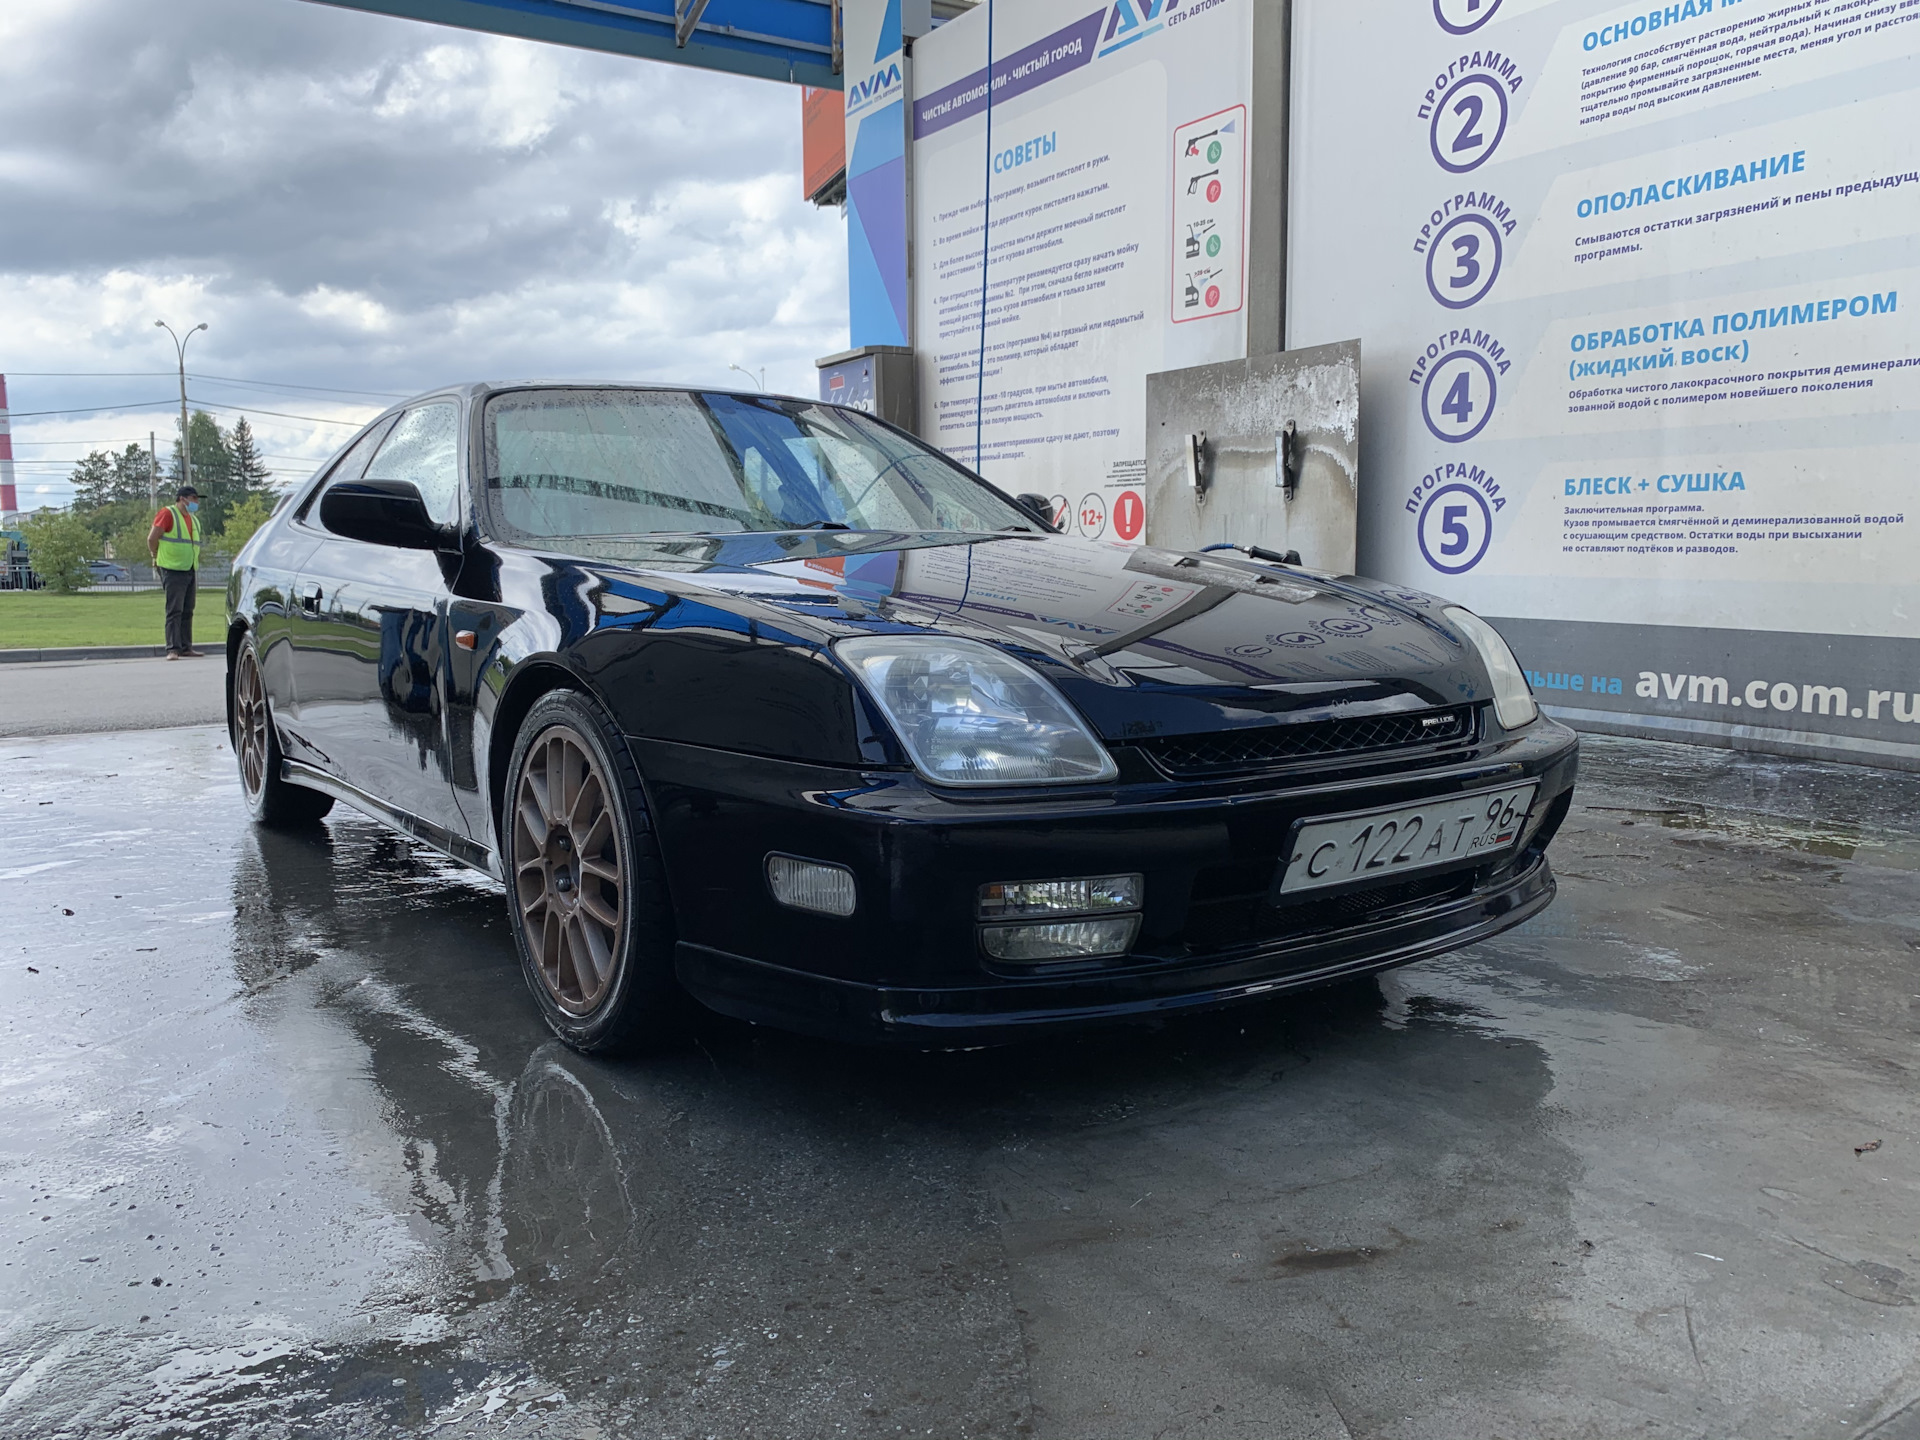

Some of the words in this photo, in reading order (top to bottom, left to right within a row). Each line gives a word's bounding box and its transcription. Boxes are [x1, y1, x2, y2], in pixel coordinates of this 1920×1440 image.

[1168, 10, 1188, 27] СЕТЬ
[1582, 0, 1712, 51] ОСНОВНАЯ
[1582, 56, 1631, 76] Технология
[1633, 36, 1696, 60] способствует
[1698, 15, 1765, 43] растворению
[1767, 0, 1811, 19] жирных
[1580, 83, 1626, 101] покрытию
[1628, 63, 1684, 88] фирменный
[1686, 52, 1732, 70] порошок,
[1735, 38, 1776, 56] горячая
[1778, 27, 1811, 43] вода).
[1814, 13, 1861, 33] Начиная
[1864, 4, 1896, 18] снизу
[1580, 94, 1628, 113] тщательно
[1630, 77, 1689, 99] промывайте
[1691, 56, 1760, 82] загрязненные
[1763, 46, 1797, 61] места,
[1800, 35, 1834, 50] меняя
[1836, 28, 1861, 43] угол
[1864, 25, 1872, 33] и
[1581, 70, 1626, 90] (давление
[1628, 65, 1638, 74] 90
[1640, 61, 1659, 71] бар,
[1661, 43, 1717, 65] смягчённая
[1719, 34, 1746, 47] вода,
[1749, 9, 1821, 38] нейтральный
[1824, 8, 1830, 16] к
[848, 63, 902, 109] AVM
[922, 100, 951, 122] ЧИСТЫЕ
[952, 75, 1007, 109] АВТОМОБИЛИ
[1013, 50, 1049, 79] ЧИСТЫЙ
[1051, 37, 1083, 67] ГОРОД
[1418, 50, 1523, 120] ПРОГРАММА
[1579, 112, 1610, 125] напора
[1612, 104, 1636, 116] воды
[1637, 99, 1655, 109] под
[1657, 87, 1700, 104] высоким
[1701, 70, 1761, 94] давлением.
[1452, 96, 1483, 153] 2
[994, 131, 1056, 174] СОВЕТЫ
[1026, 174, 1055, 189] возьмите
[1056, 162, 1085, 179] пистолет
[1577, 150, 1805, 218] ОПОЛАСКИВАНИЕ
[990, 239, 1015, 251] качества
[1064, 212, 1093, 229] моечный
[1094, 204, 1126, 220] пистолет
[998, 211, 1024, 226] держите
[1043, 193, 1075, 210] пистолета
[1413, 192, 1517, 254] ПРОГРАММА
[1575, 227, 1640, 246] Смываются
[1643, 216, 1692, 233] остатки
[1695, 196, 1778, 223] загрязнений
[1782, 196, 1791, 206] и
[1795, 188, 1831, 203] пены
[990, 274, 1025, 289] температуре
[1026, 261, 1072, 282] рекомендуется
[1073, 256, 1091, 268] сразу
[1092, 250, 1115, 262] начать
[1116, 243, 1139, 255] мойку
[1047, 275, 1072, 287] сначала
[1073, 270, 1092, 280] бегло
[1093, 261, 1124, 275] нанесите
[1450, 234, 1480, 288] 3
[1574, 243, 1642, 264] программы.
[1020, 292, 1056, 307] автомобиля
[1062, 285, 1085, 296] только
[1086, 280, 1105, 291] затем
[1006, 335, 1039, 349] (программа
[1061, 322, 1088, 338] грязный
[1102, 310, 1144, 328] недомытый
[1570, 318, 1704, 352] ОБРАБОТКА
[1712, 291, 1897, 334] ПОЛИМЕРОМ
[1023, 344, 1048, 356] который
[1049, 340, 1079, 352] обладает
[1409, 328, 1512, 385] ПРОГРАММА
[1569, 346, 1674, 381] (жидкий
[1681, 339, 1748, 365] воск)
[1047, 382, 1067, 391] мытье
[1078, 388, 1110, 399] включить
[1441, 372, 1473, 423] 4
[1568, 387, 1622, 400] Обработка
[1625, 383, 1668, 393] чистого
[1670, 373, 1764, 390] лакокрасочного
[1767, 366, 1830, 380] покрытия
[1833, 357, 1920, 376] деминерали
[1568, 400, 1615, 413] зованной
[1618, 397, 1650, 409] водой
[1662, 392, 1727, 405] полимером
[1730, 386, 1798, 399] новейшего
[1801, 379, 1873, 392] поколения
[992, 436, 1044, 448] монетоприемники
[1045, 434, 1063, 444] сдачу
[1092, 428, 1120, 437] поэтому
[1405, 462, 1507, 514] ПРОГРАММА
[1564, 476, 1632, 495] БЛЕСК
[1638, 478, 1650, 491] +
[1656, 471, 1745, 493] СУШКА
[1082, 509, 1103, 526] 12+
[1441, 505, 1469, 556] 5
[1563, 519, 1589, 529] Кузов
[1591, 519, 1656, 528] промывается
[1658, 516, 1719, 526] смягчённой
[1731, 516, 1860, 527] деминерализованной
[1864, 516, 1903, 525] водой
[1564, 506, 1643, 514] Заключительная
[1645, 505, 1704, 515] программа.
[1569, 533, 1628, 541] осушающим
[1630, 532, 1686, 541] средством.
[1689, 530, 1733, 539] Остатки
[1736, 532, 1765, 540] воды
[1768, 532, 1789, 541] при
[1626, 544, 1674, 554] подтёков
[1685, 546, 1738, 555] разводов.
[1592, 676, 1623, 695] на
[1635, 671, 1920, 723] avm.com.ru
[1486, 794, 1517, 833] 96
[1471, 832, 1496, 850] RUS
